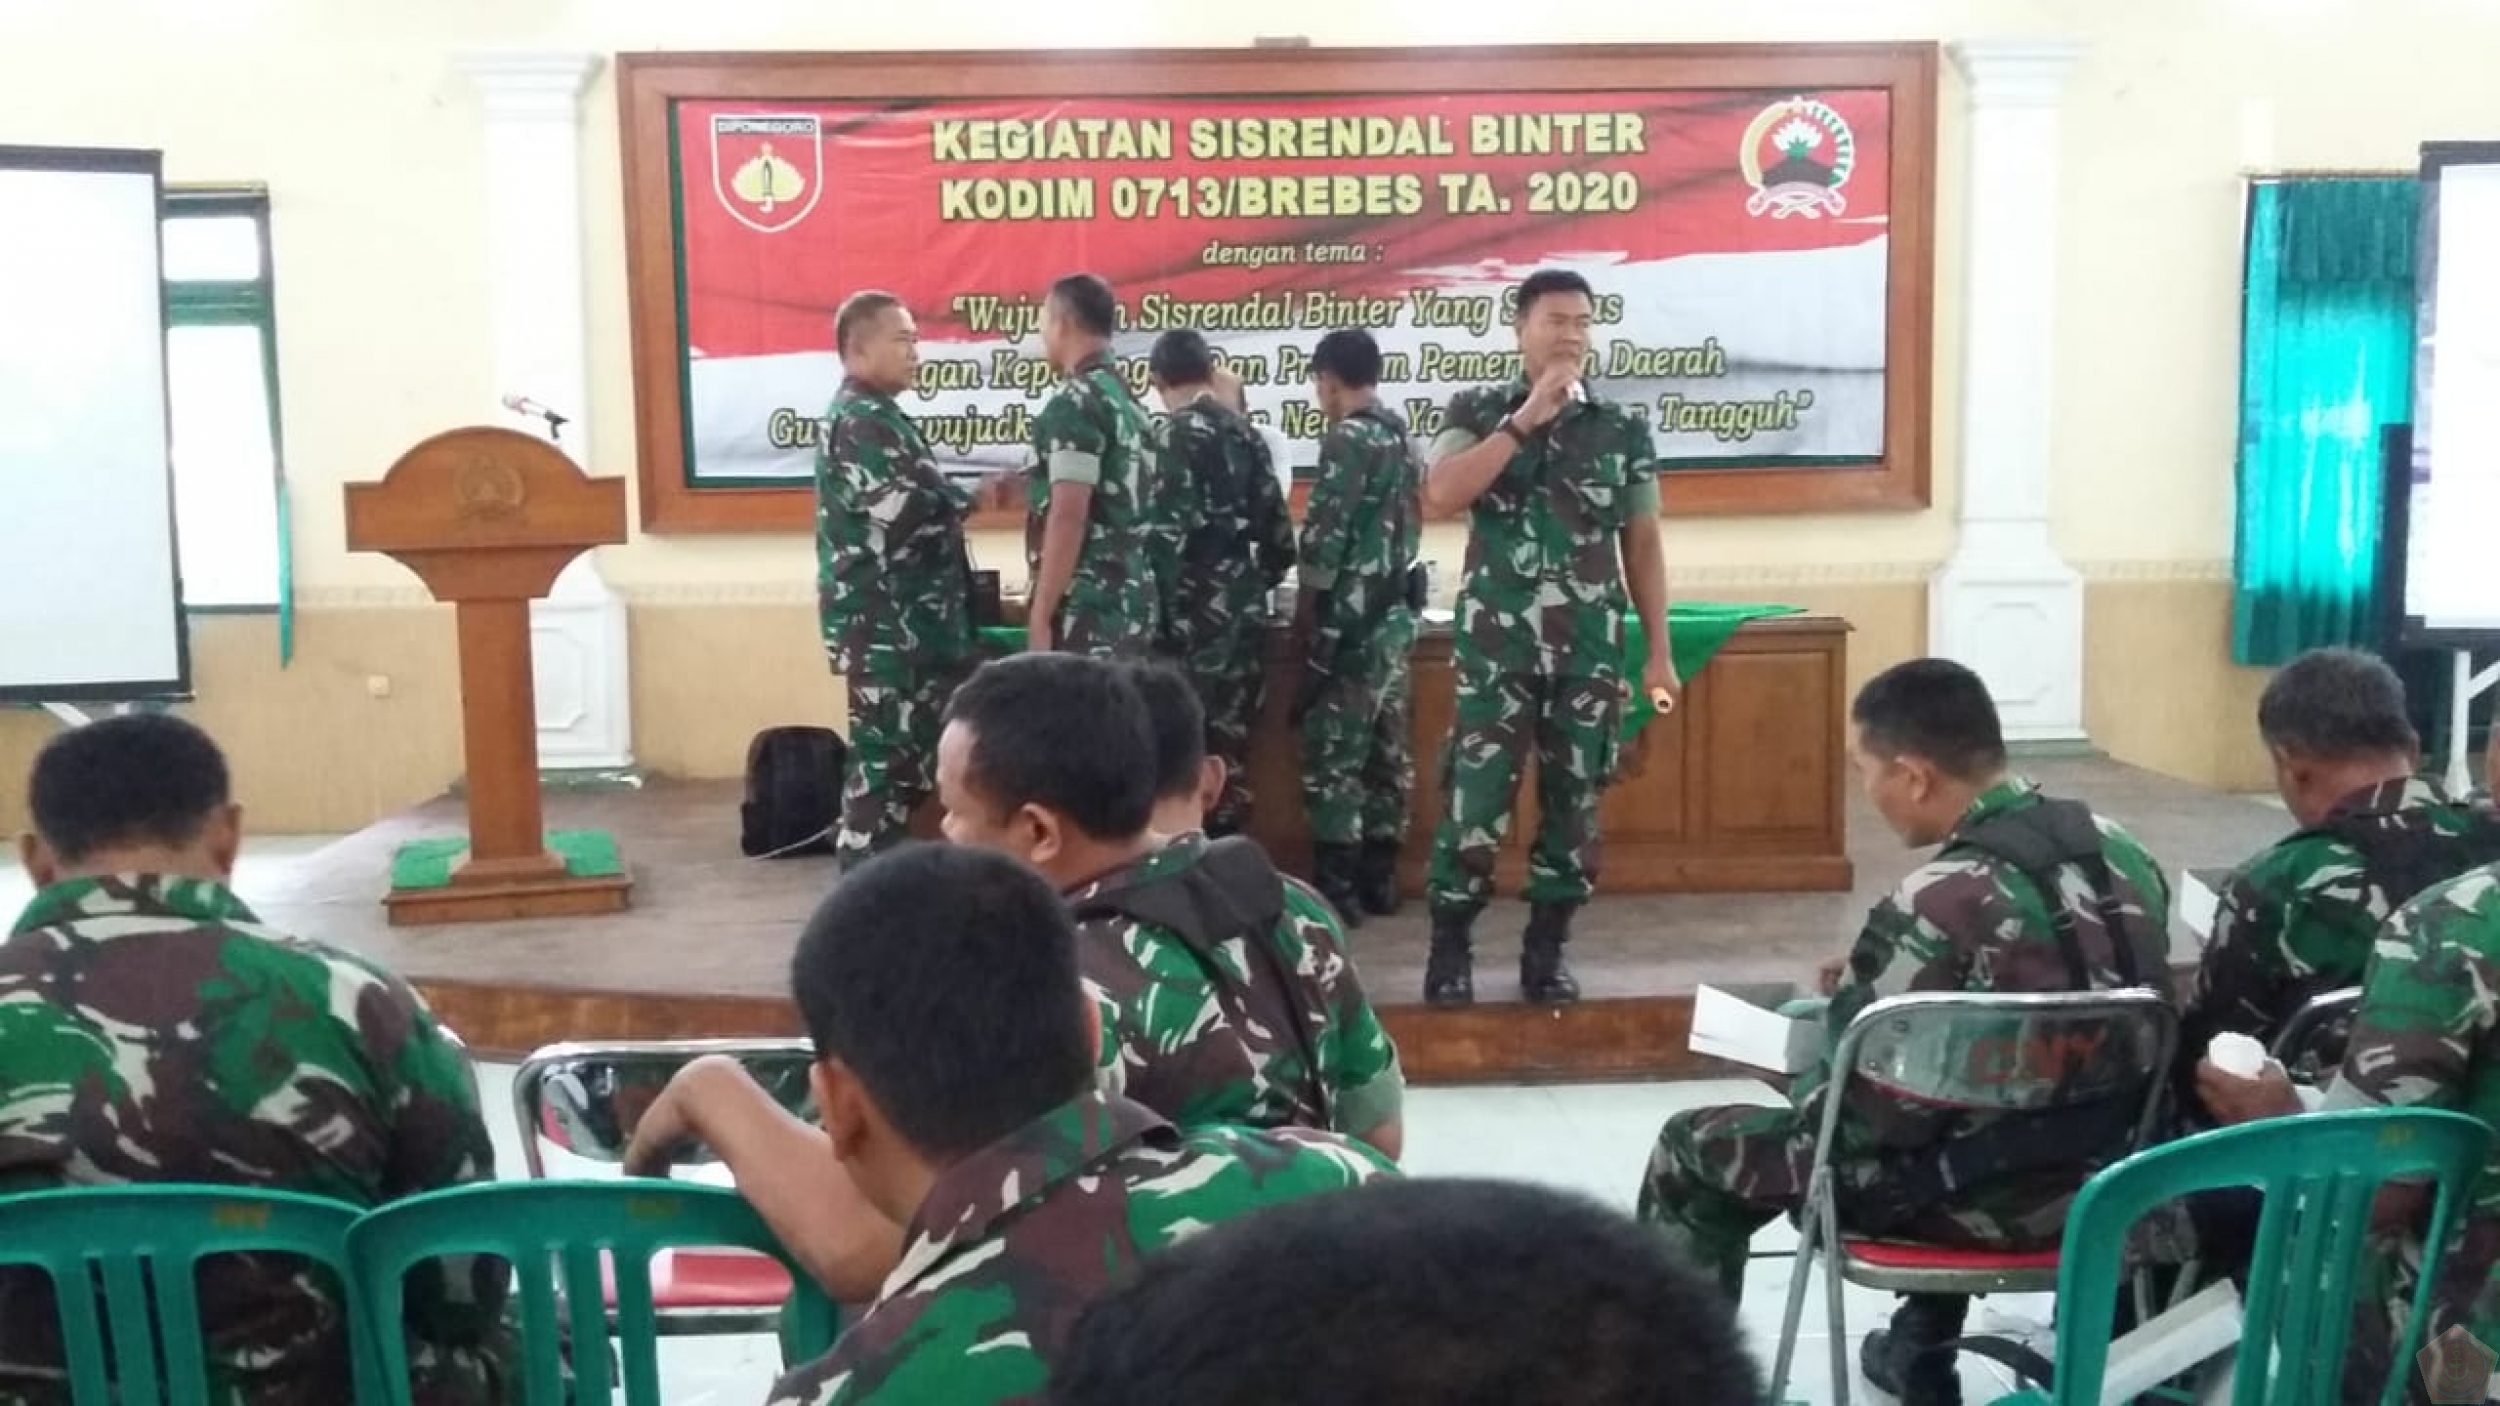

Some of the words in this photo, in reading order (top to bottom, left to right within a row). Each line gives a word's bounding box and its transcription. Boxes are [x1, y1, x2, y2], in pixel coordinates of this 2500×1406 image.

[932, 118, 1171, 161] KEGIATAN
[1189, 115, 1454, 160] SISRENDAL
[1470, 112, 1646, 155] BINTER
[940, 176, 1095, 221] KODIM
[1110, 173, 1424, 219] 0713/BREBES
[1438, 172, 1512, 215] TA.
[1527, 170, 1639, 213] 2020
[1202, 239, 1296, 268] dengan
[1305, 242, 1366, 264] tema
[1138, 292, 1294, 332] Sisrendal
[1301, 290, 1402, 329] Binter
[1410, 287, 1493, 336] Yang
[1605, 338, 1729, 379] Daerah
